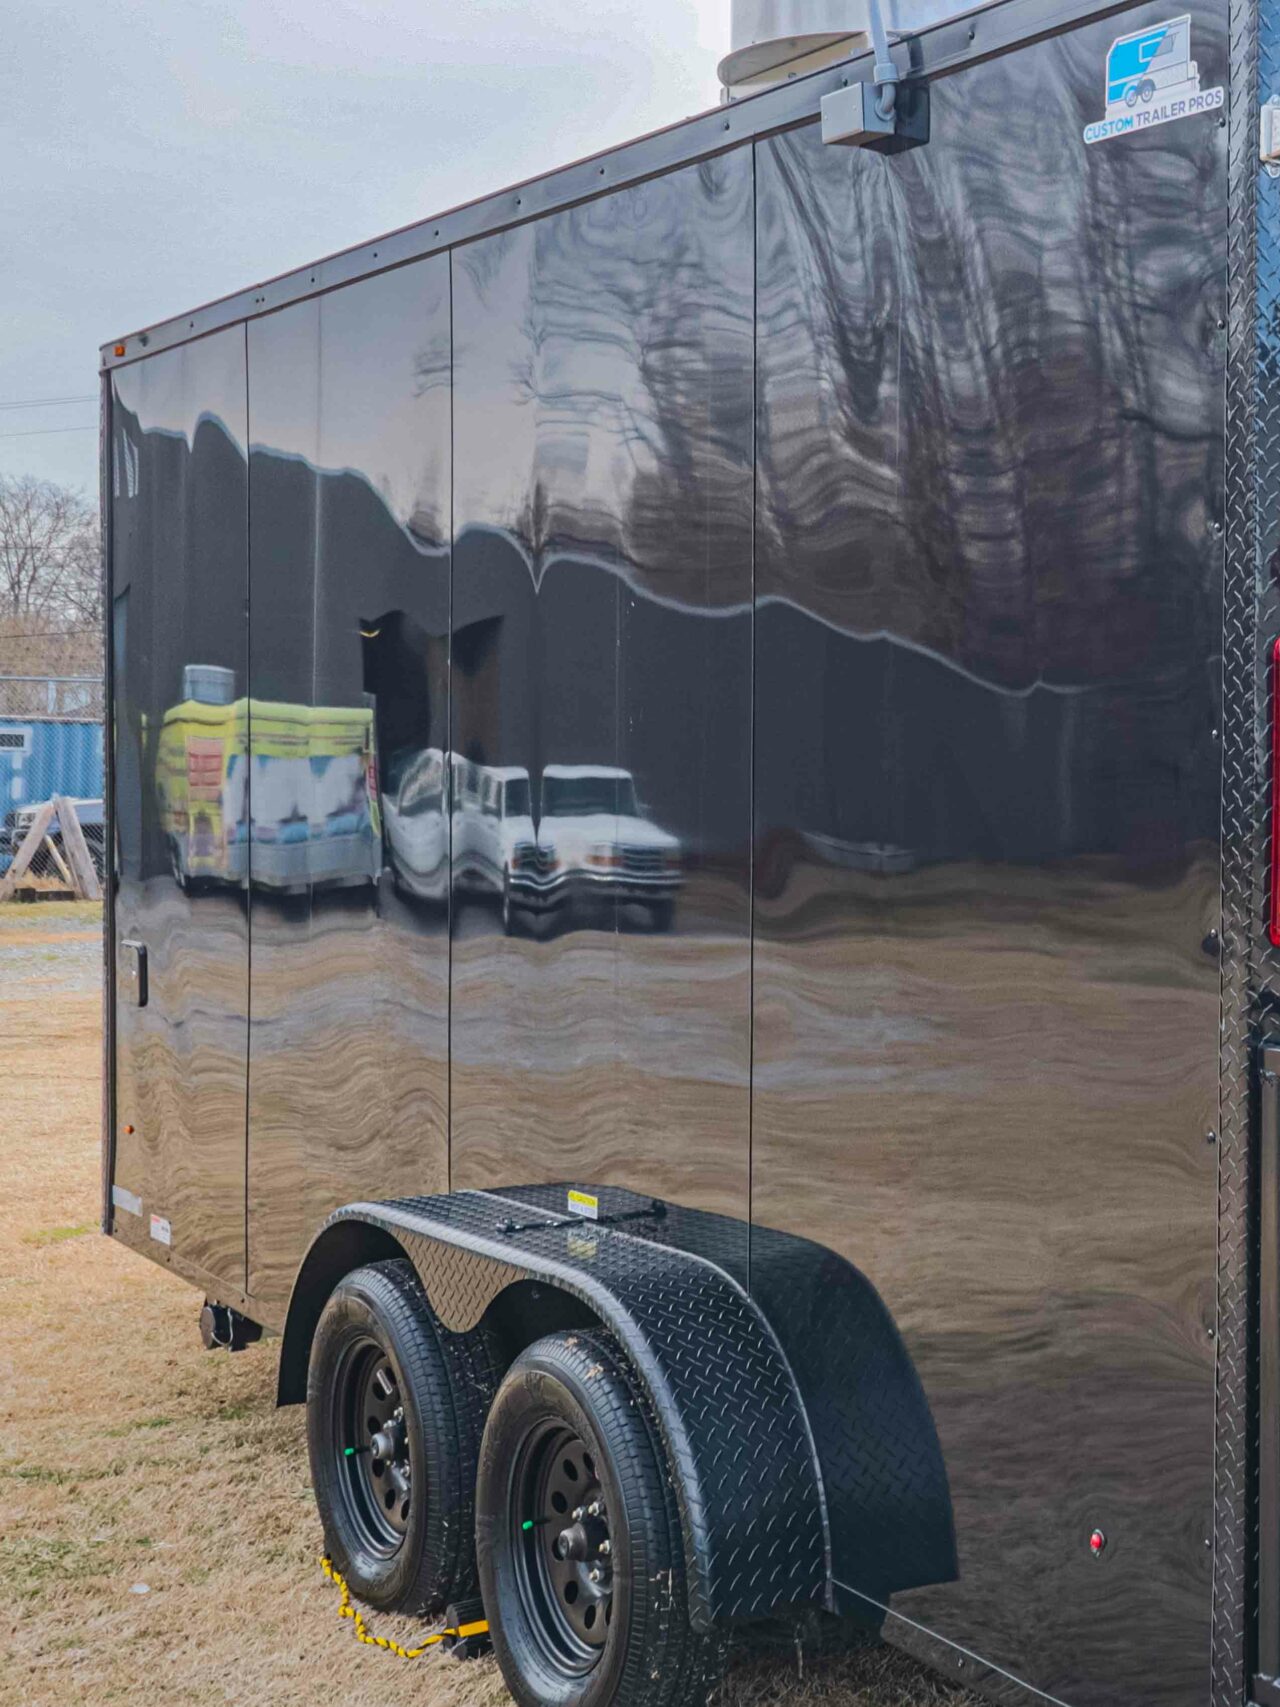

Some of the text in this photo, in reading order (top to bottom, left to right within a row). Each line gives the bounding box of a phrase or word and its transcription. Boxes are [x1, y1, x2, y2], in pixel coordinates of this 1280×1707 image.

[1085, 90, 1222, 140] CUSTOM TRAILER PROS
